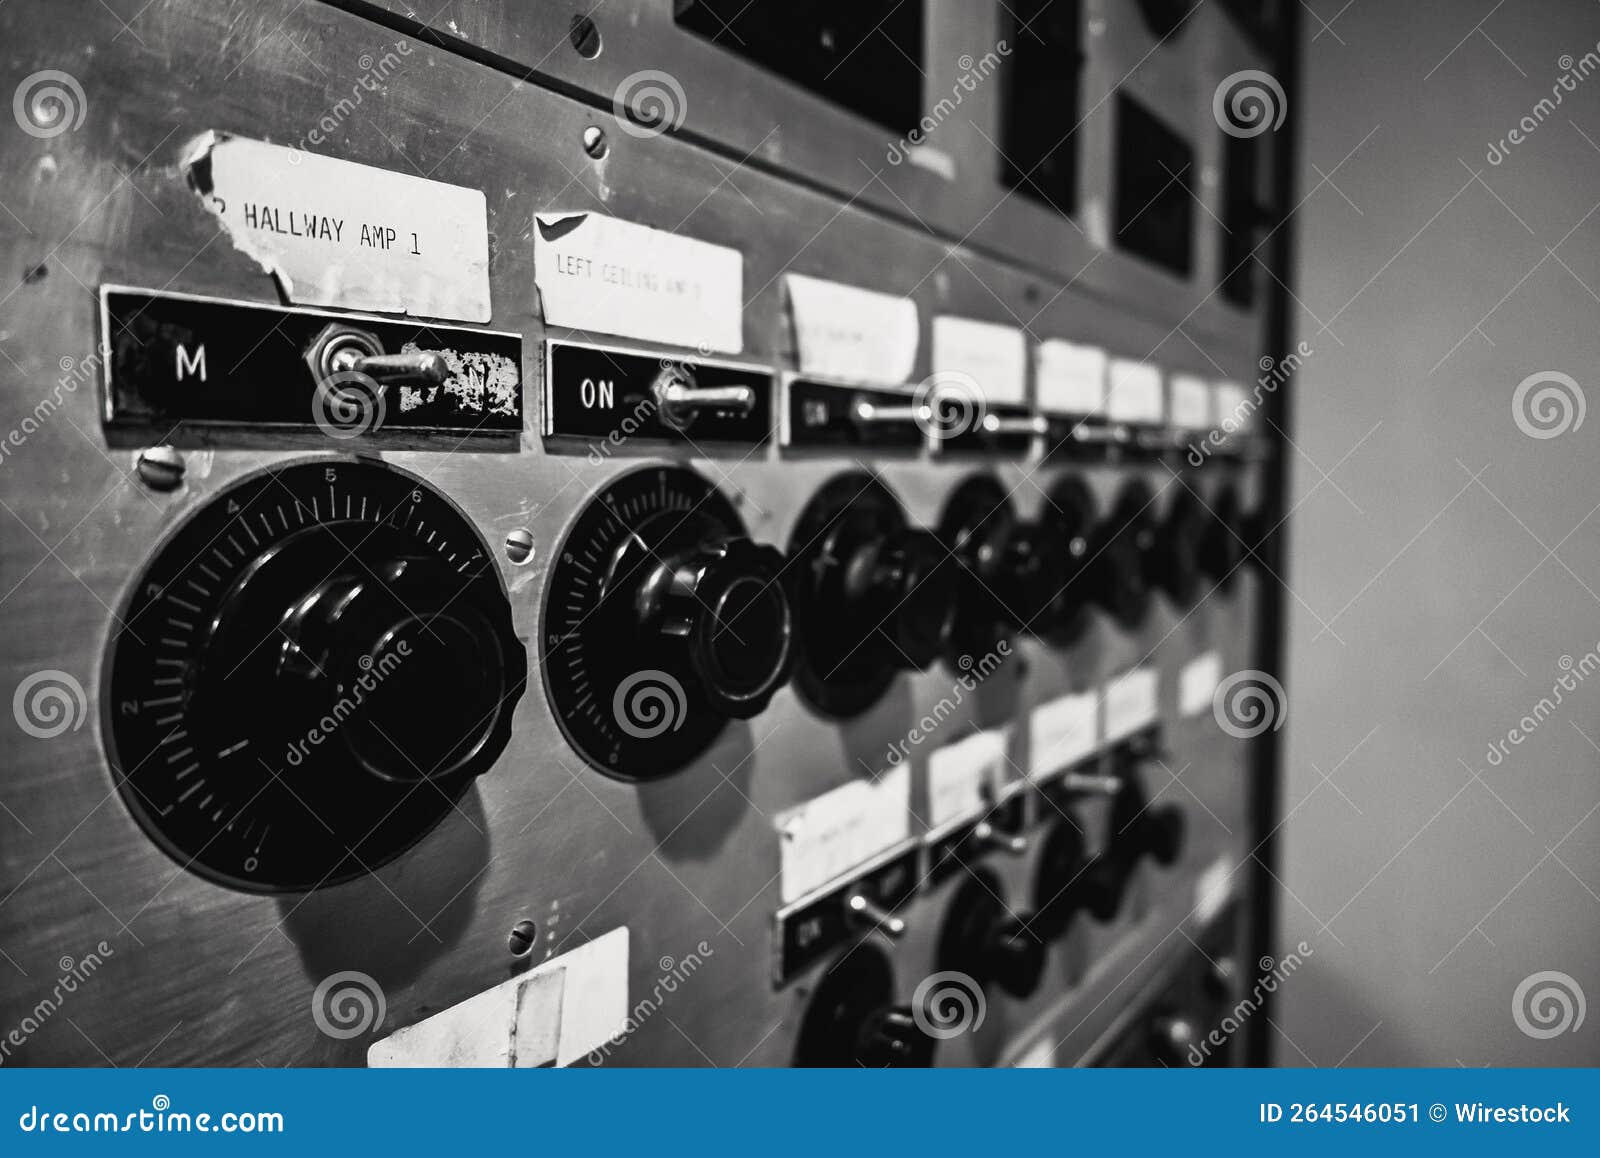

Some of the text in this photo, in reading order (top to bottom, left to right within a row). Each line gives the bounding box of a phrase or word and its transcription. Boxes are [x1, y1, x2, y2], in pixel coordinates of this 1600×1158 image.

[244, 202, 344, 242] HALLWAY
[360, 223, 396, 250] AMP
[410, 232, 422, 256] 1
[557, 253, 592, 278] LEFT
[176, 343, 207, 382] M
[580, 377, 614, 409] ON
[411, 490, 423, 503] 6
